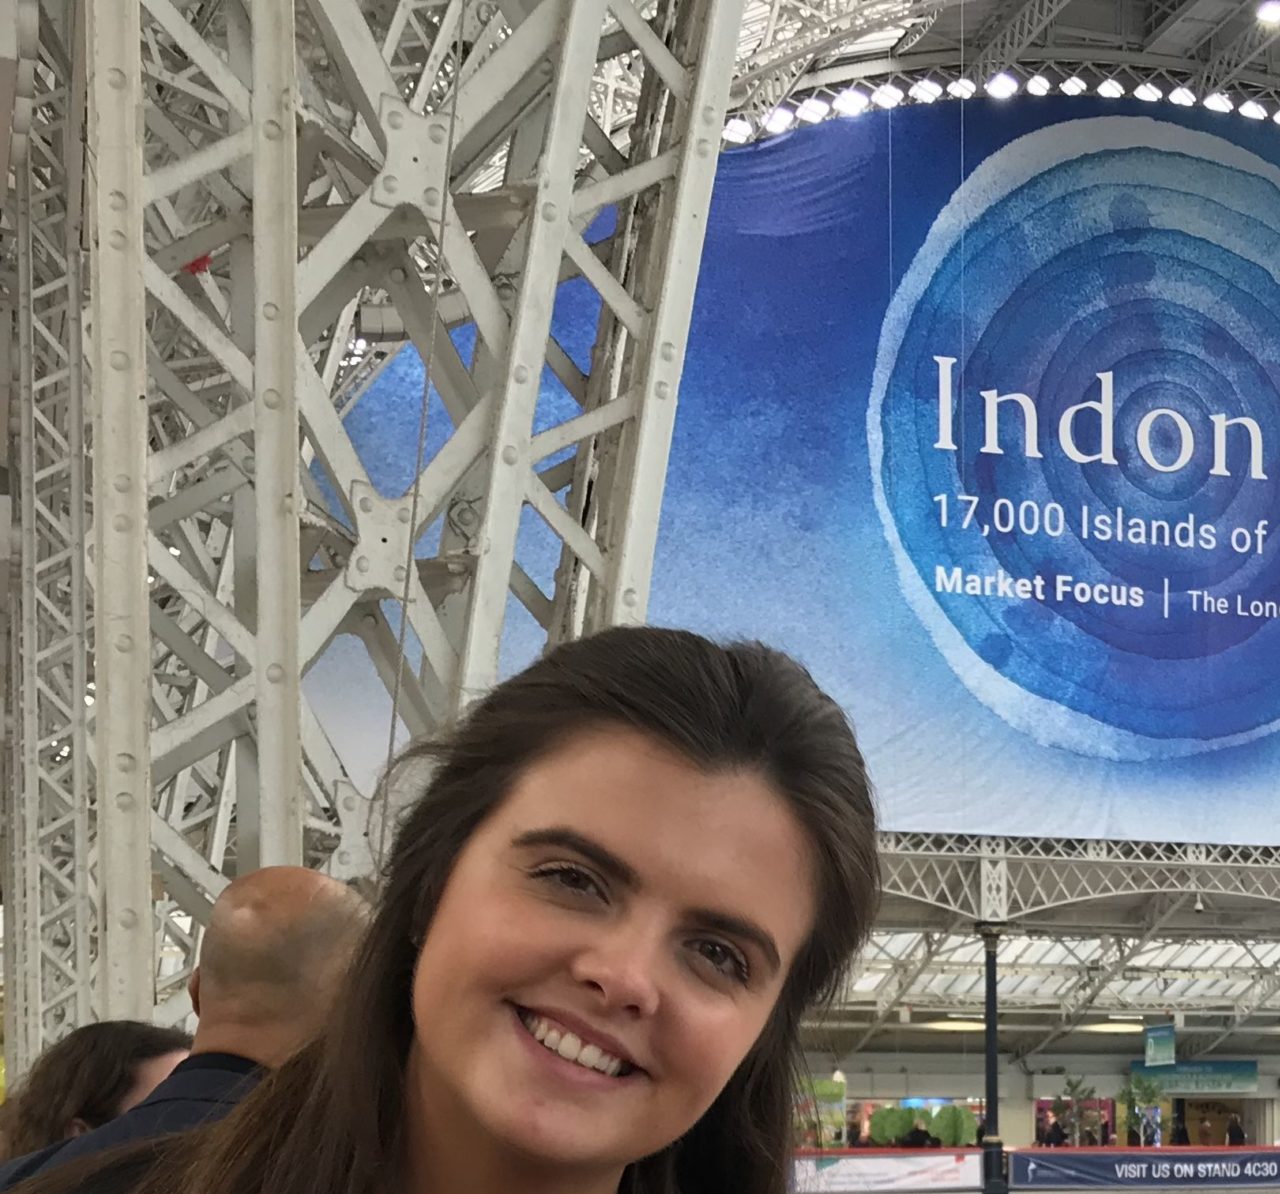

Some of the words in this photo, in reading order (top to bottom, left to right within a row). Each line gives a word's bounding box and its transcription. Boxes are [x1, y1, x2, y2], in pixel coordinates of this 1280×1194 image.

[933, 493, 1065, 537] 17,000
[1081, 505, 1217, 550] Islands
[1231, 519, 1269, 555] of
[935, 565, 1046, 600] Market
[1055, 574, 1145, 607] Focus
[1187, 590, 1229, 614] The
[1115, 1163, 1148, 1178] VISIT
[1151, 1163, 1170, 1178] US
[1173, 1163, 1195, 1178] ON
[1197, 1163, 1240, 1178] STAND
[1244, 1162, 1278, 1177] 4C30
